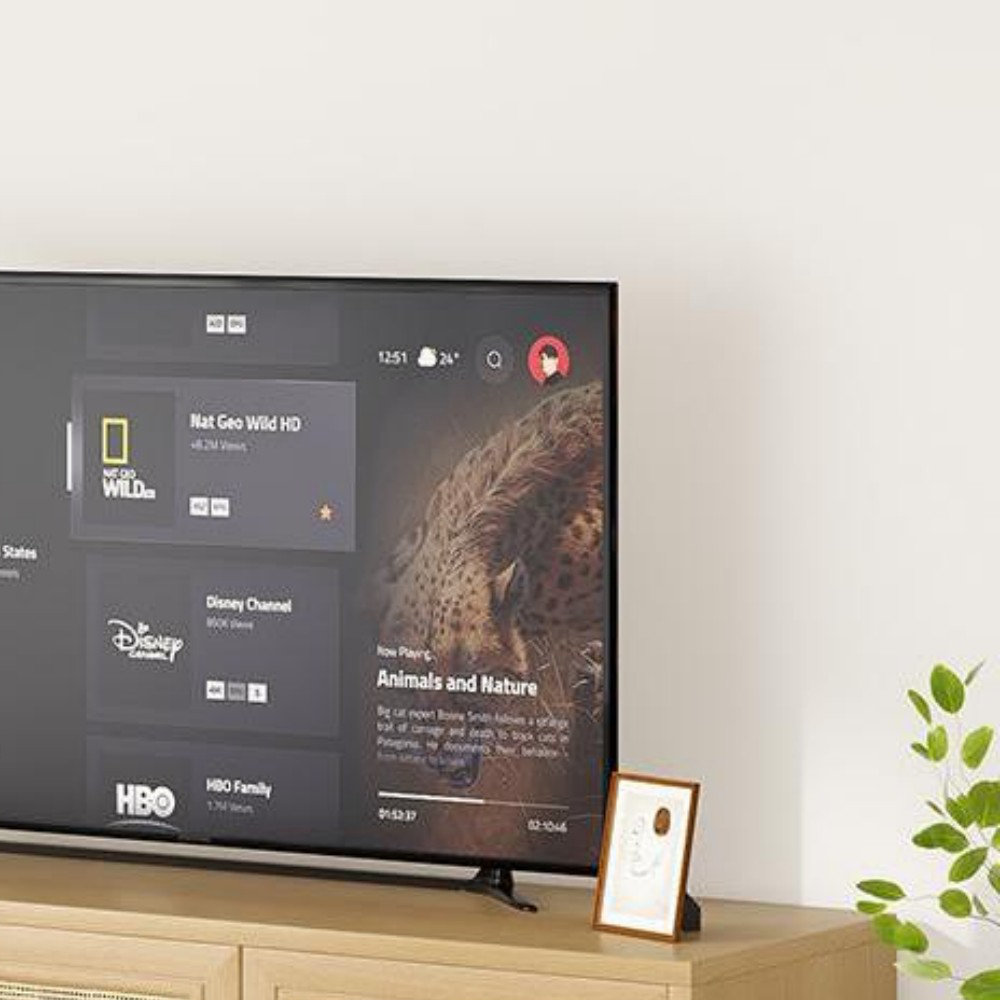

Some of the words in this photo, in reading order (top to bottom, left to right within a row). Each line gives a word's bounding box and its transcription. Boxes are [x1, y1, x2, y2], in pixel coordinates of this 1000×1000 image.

[190, 412, 216, 430] Nat
[217, 413, 243, 431] Geo
[246, 414, 276, 432] Wild
[280, 416, 301, 432] HD
[102, 478, 145, 498] WILD
[2, 545, 38, 560] States
[206, 595, 244, 612] Disney
[246, 597, 292, 613] Channel
[376, 670, 443, 691] Animals
[446, 674, 477, 693] and
[480, 675, 539, 697] Nature
[206, 777, 231, 793] HBO
[234, 779, 272, 799] Family
[115, 783, 176, 818] HBO
